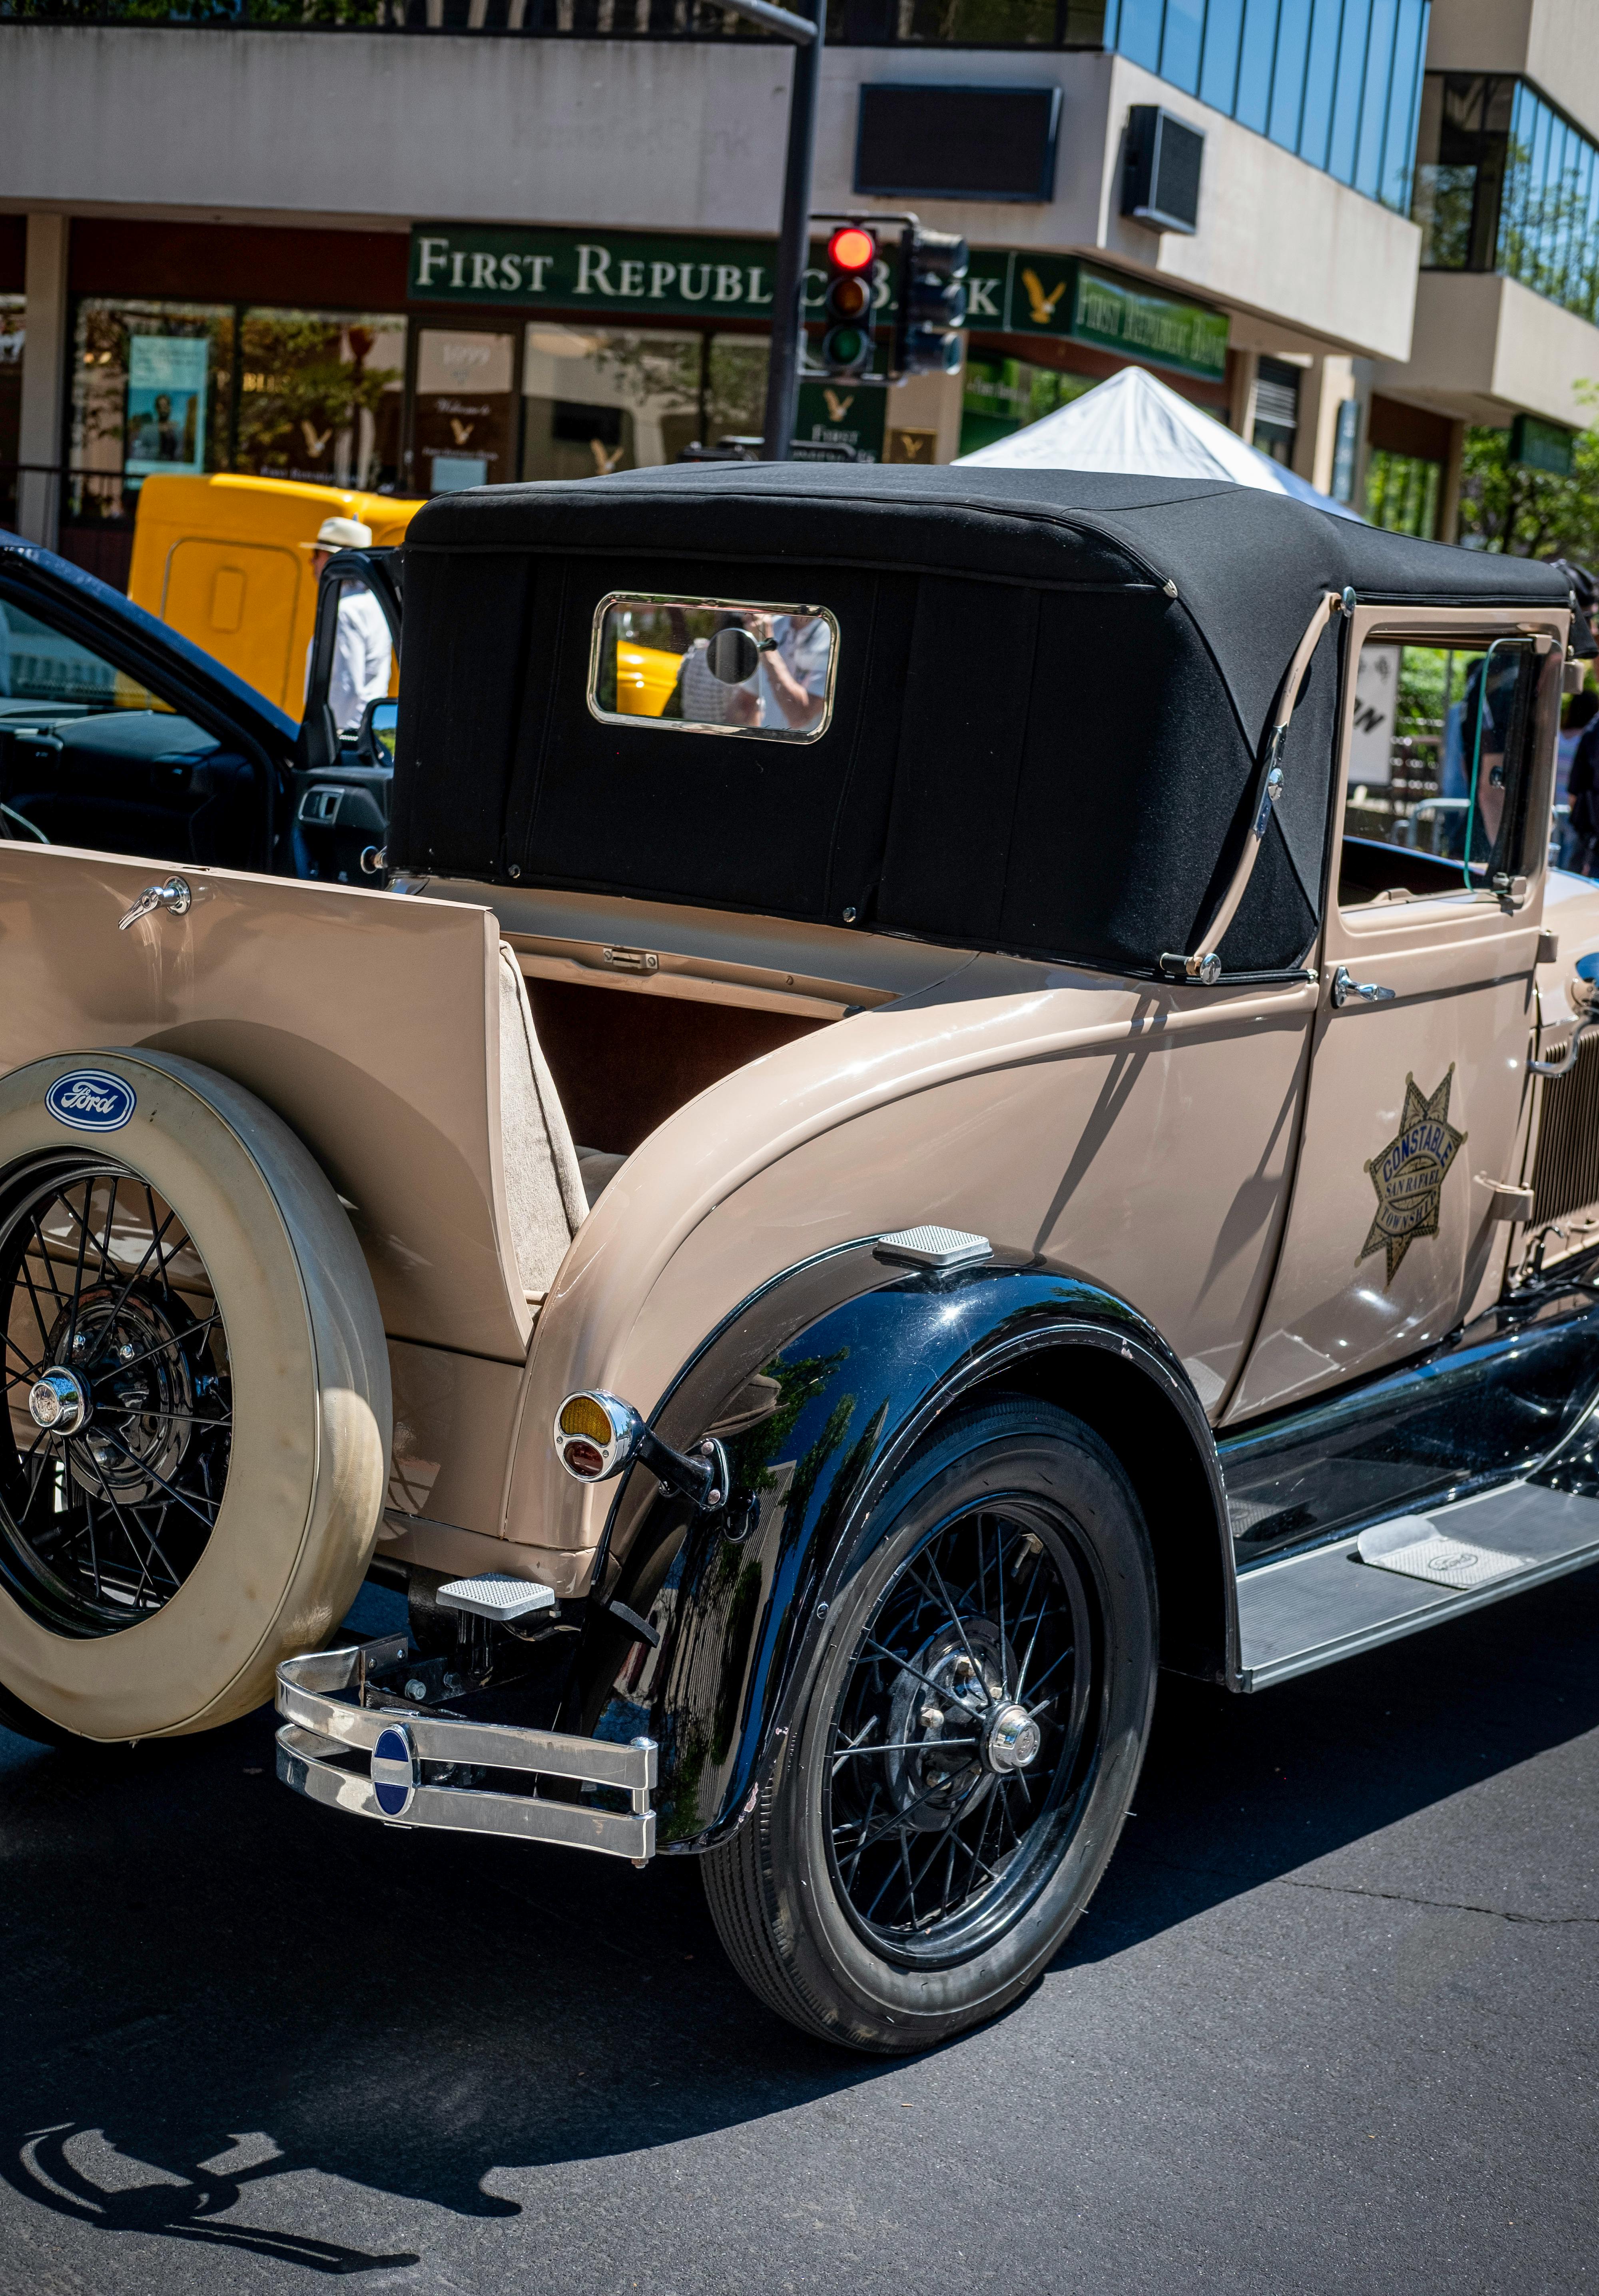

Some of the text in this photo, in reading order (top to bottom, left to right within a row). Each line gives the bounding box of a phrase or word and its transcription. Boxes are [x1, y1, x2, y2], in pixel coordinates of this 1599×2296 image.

[572, 244, 828, 307] REPUBLC
[871, 259, 1001, 315] BK
[61, 1081, 118, 1114] Ford
[1383, 1124, 1452, 1182] CONSTABLE
[1386, 1169, 1439, 1198] SAN RAFAEL
[1381, 1190, 1436, 1229] TOWNSHIP
